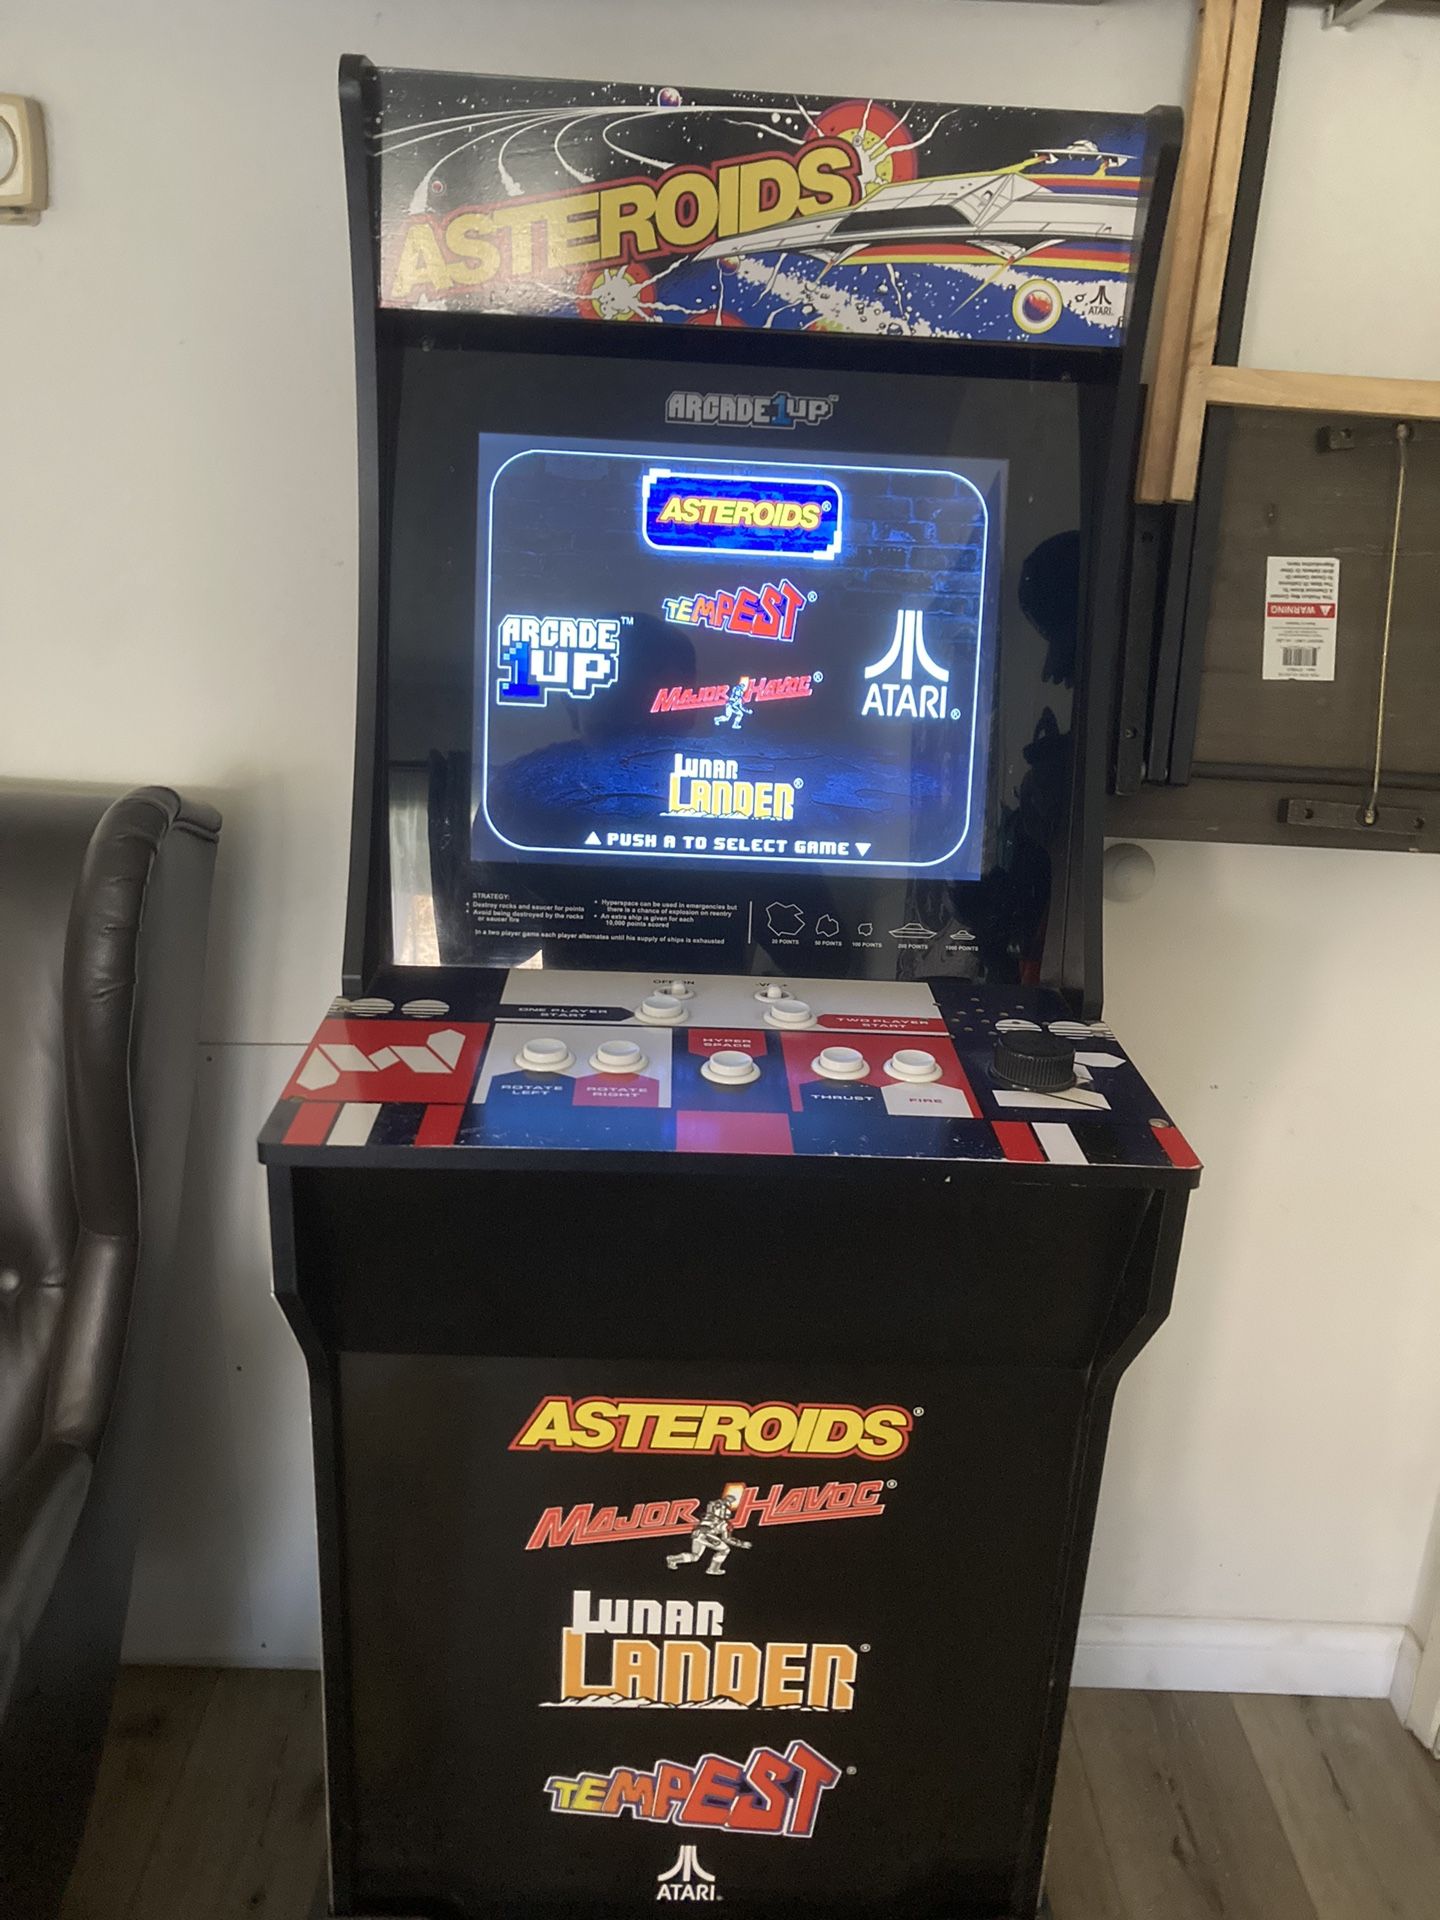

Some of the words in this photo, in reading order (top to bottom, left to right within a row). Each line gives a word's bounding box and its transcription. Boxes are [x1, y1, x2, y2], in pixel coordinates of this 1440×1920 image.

[391, 146, 853, 297] ASTEROIDS
[1088, 305, 1112, 316] ATARI
[657, 497, 824, 529] ASTEROIDS
[662, 579, 806, 641] TEMPEST
[1271, 605, 1315, 614] WARNING
[501, 617, 619, 650] ARCADE
[650, 685, 730, 713] MAJOR
[743, 675, 813, 703] HAVOC
[861, 684, 947, 719] ATARI
[669, 773, 794, 820] LANDER
[607, 833, 657, 847] PUSH
[664, 836, 676, 849] A
[683, 836, 707, 849] TO
[713, 838, 788, 853] SELECT
[794, 841, 850, 855] GAME
[472, 892, 510, 900] STRATEGY:
[473, 901, 497, 909] Destroy
[565, 904, 584, 912] points
[686, 903, 725, 911] emergencies
[512, 910, 544, 918] destroyed
[545, 911, 553, 919] by
[650, 915, 667, 923] given
[669, 908, 698, 916] explosion
[710, 910, 732, 918] reentry
[578, 932, 609, 940] alternates
[637, 935, 658, 943] supply
[511, 1398, 912, 1460] ASTEROIDS
[525, 1499, 699, 1549] MAJOR
[730, 1481, 885, 1527] HAVOC
[573, 1591, 724, 1635] LUNAR
[562, 1627, 857, 1710] LANDER
[545, 1741, 841, 1836] TEMPEST
[657, 1884, 715, 1901] ATARI
